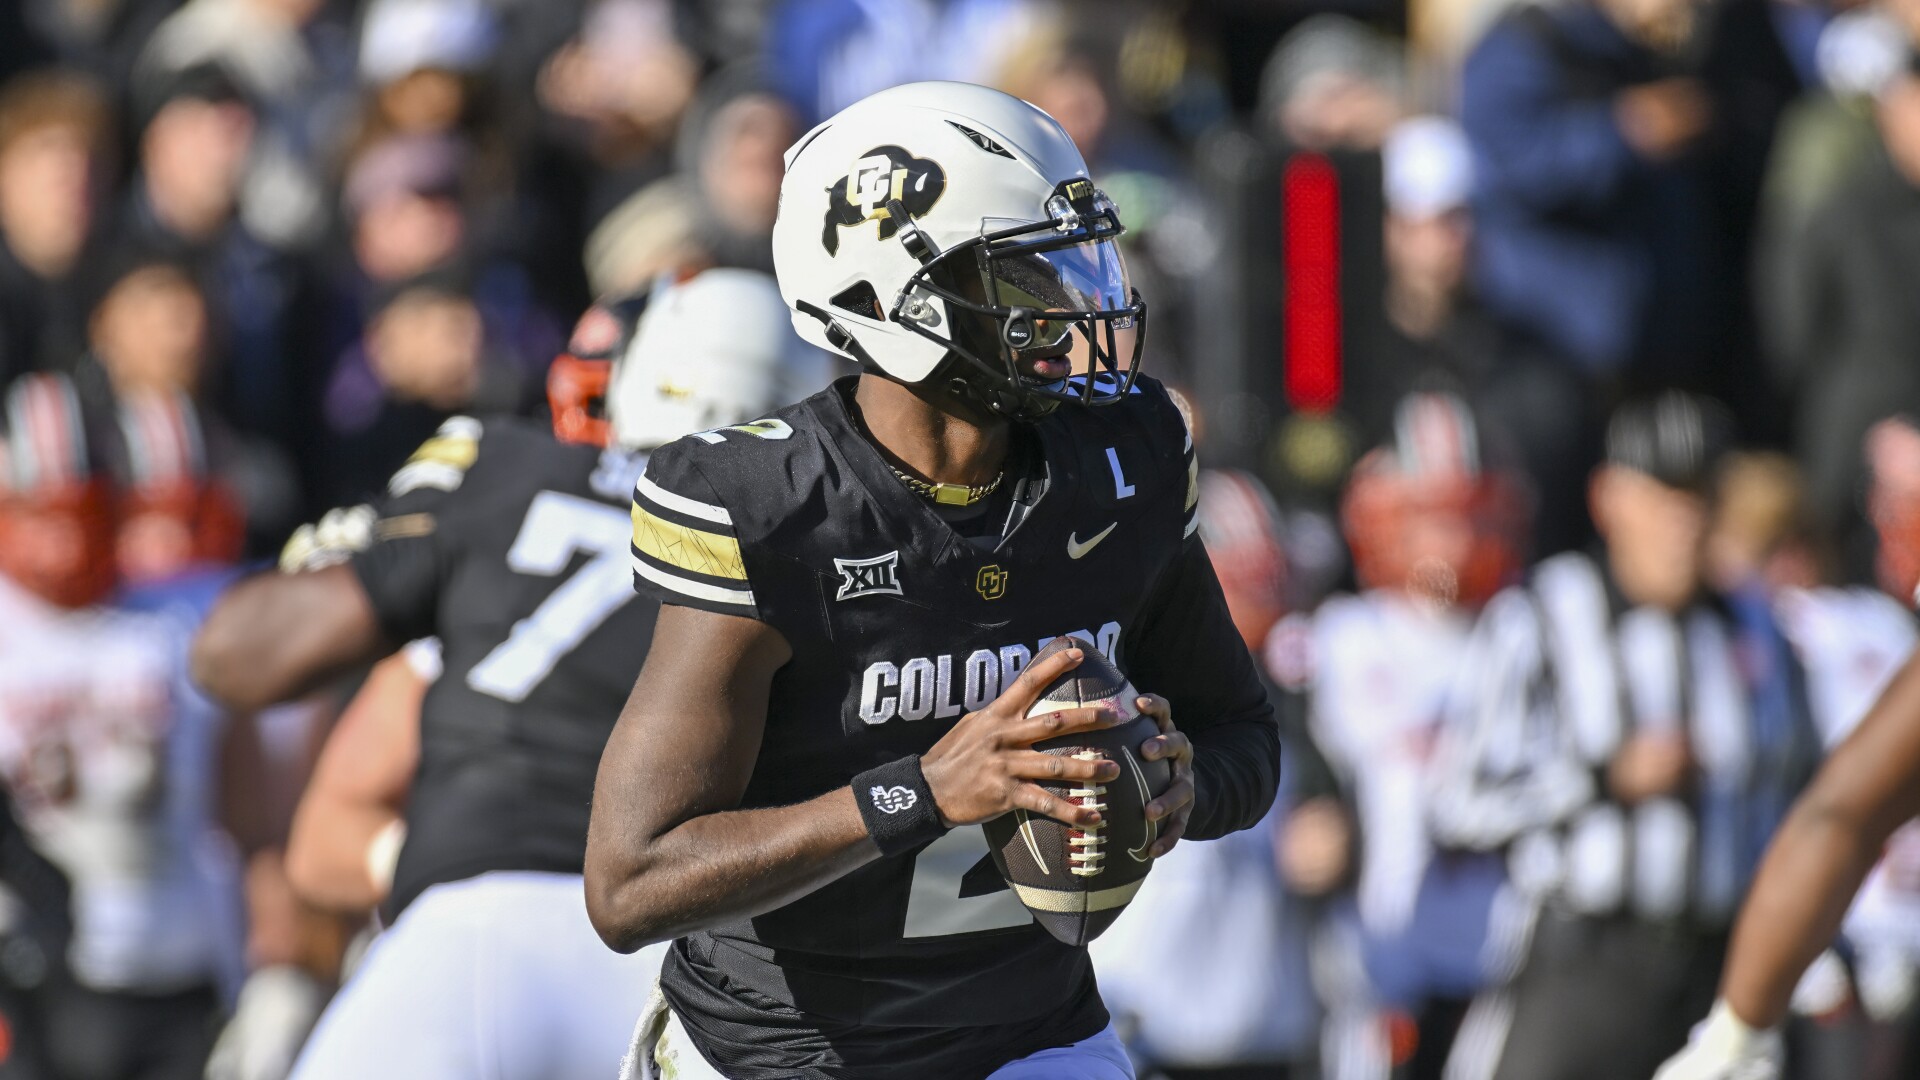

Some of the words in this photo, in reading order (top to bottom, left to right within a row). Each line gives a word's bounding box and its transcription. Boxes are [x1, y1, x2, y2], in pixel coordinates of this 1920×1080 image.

[1105, 446, 1136, 499] L
[839, 555, 899, 598] XII
[976, 564, 1008, 600] CU
[859, 620, 1122, 725] COLORO
